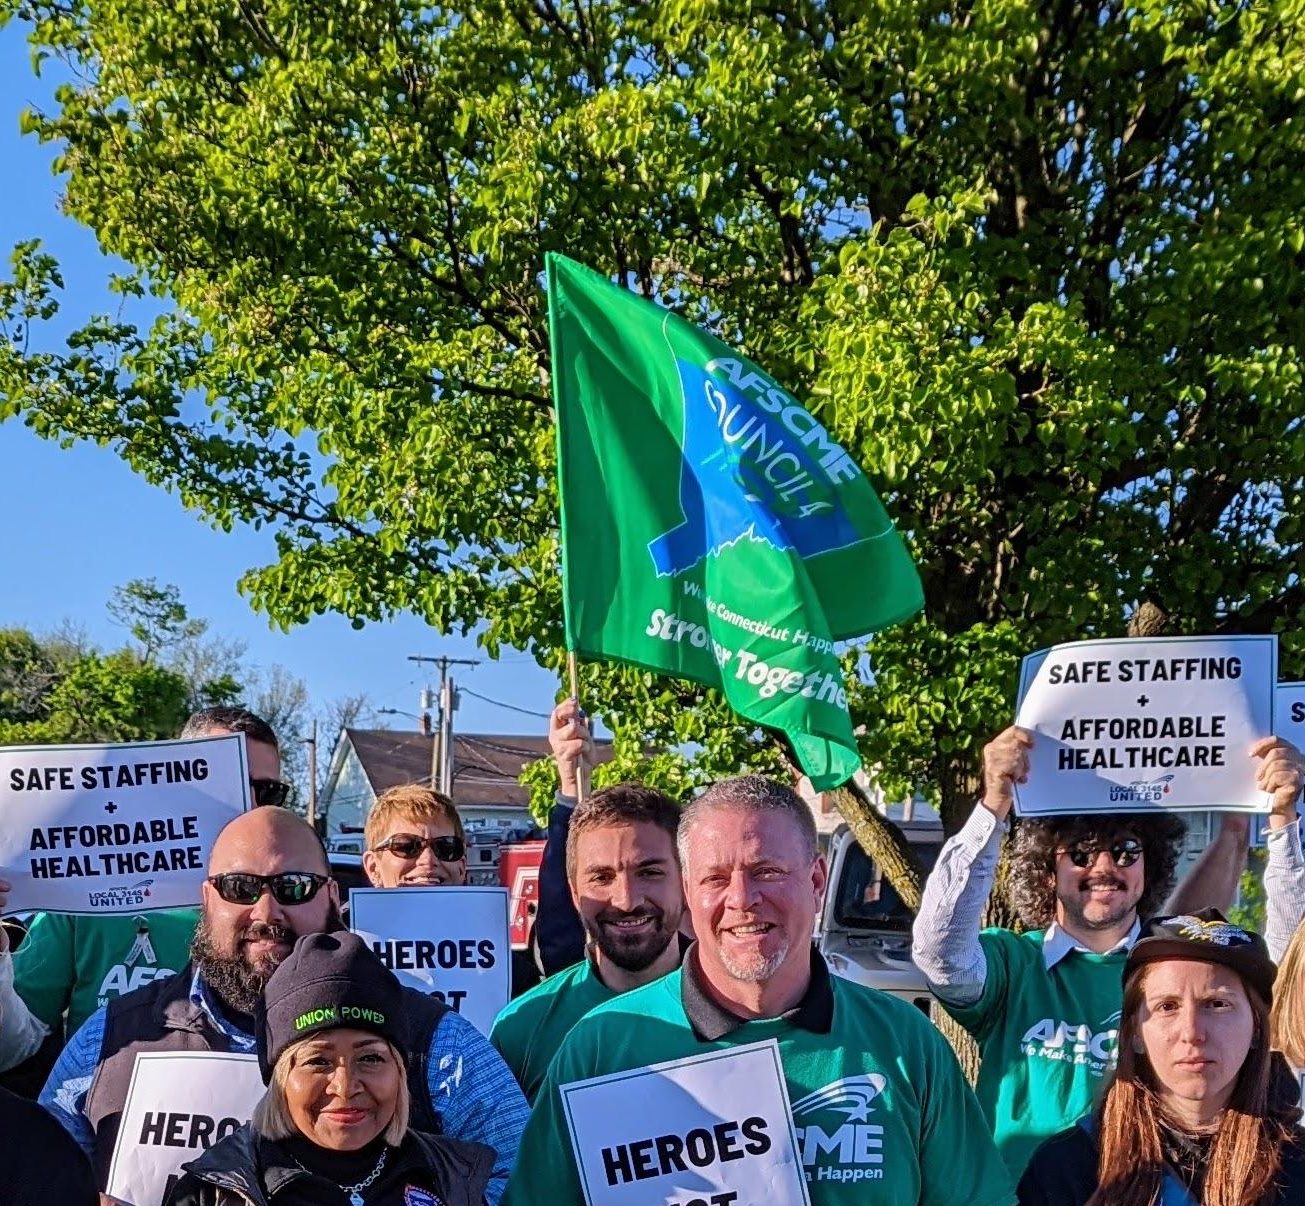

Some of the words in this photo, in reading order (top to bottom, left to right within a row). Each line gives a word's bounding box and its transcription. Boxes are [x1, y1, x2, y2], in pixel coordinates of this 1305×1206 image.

[705, 357, 862, 485] AFSCME
[716, 603, 790, 641] Connecticut
[793, 629, 835, 655] Happ
[735, 649, 849, 712] Togethe
[1048, 661, 1111, 685] SAFE
[1118, 656, 1242, 682] STAFFING
[1137, 694, 1149, 707] +
[1060, 715, 1226, 741] AFFORDABLE
[1058, 745, 1226, 770] HEALTHCARE
[10, 767, 75, 791] SAFE
[81, 758, 209, 790] STAFFING
[1110, 785, 1138, 793] LOCAL
[1110, 792, 1162, 801] UNITED
[104, 801, 118, 813] +
[30, 816, 199, 850] AFFORDABLE
[30, 846, 203, 879] HEALTHCARE
[89, 891, 119, 899] LOCAL
[89, 896, 144, 907] UNITED
[373, 939, 496, 970] HEROES
[295, 1007, 335, 1030] UNION
[341, 1006, 385, 1024] POWER
[139, 1112, 243, 1149] HERO
[601, 1116, 772, 1186] HEROES
[818, 1166, 883, 1183] Happen
